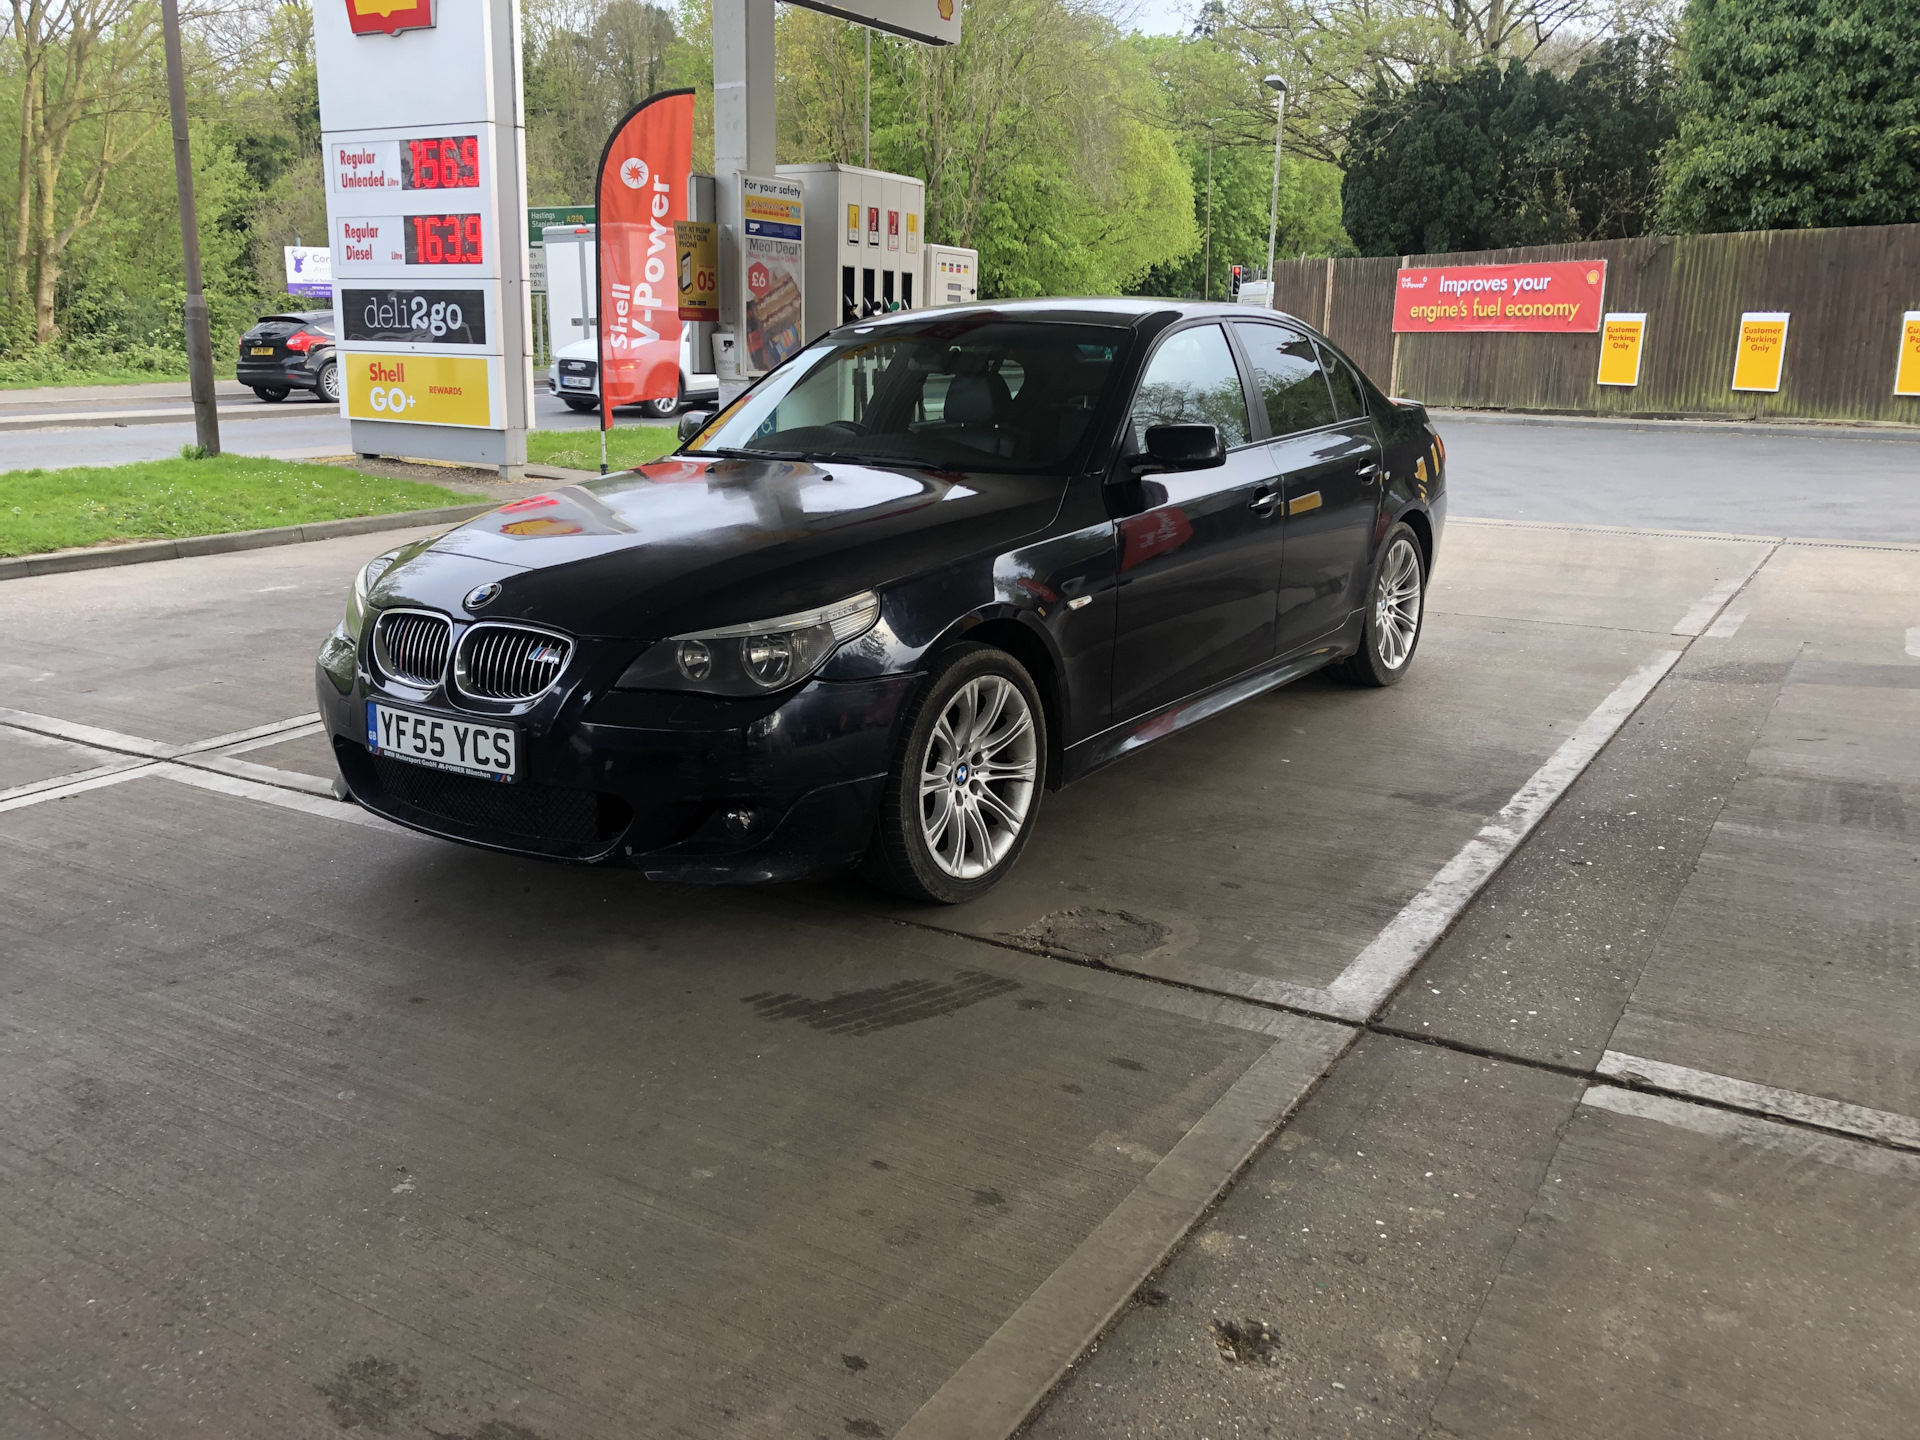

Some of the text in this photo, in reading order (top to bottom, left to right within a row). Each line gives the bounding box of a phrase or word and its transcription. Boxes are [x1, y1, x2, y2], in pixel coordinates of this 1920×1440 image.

[340, 138, 480, 188] Regular 156.9
[341, 170, 399, 188] Unleaded Litre
[744, 179, 801, 198] For your safety
[531, 212, 556, 220] Hastings
[344, 222, 379, 243] Regular
[346, 215, 483, 263] Diesel Litre 163.9
[749, 239, 773, 252] Meal
[312, 254, 331, 263] Cor
[631, 175, 670, 349] V-Power
[697, 270, 716, 292] 05
[752, 272, 766, 287] £6
[1439, 276, 1552, 297] Improves your
[364, 296, 463, 337] deli2go
[610, 283, 631, 349] Shell
[1410, 297, 1580, 323] engine's fuel economy
[1608, 334, 1636, 342] Parking
[1743, 326, 1782, 334] Customer
[1745, 335, 1778, 344] Parking
[1612, 342, 1630, 350] Only
[1750, 344, 1770, 353] Only
[369, 362, 405, 383] Shell
[370, 386, 416, 413] GO+
[429, 386, 462, 396] REWARDS
[368, 711, 511, 769] GB YF55 YCS
[396, 753, 421, 764] Motorsport
[421, 760, 437, 768] GmbH
[438, 763, 465, 774] M-POWER
[465, 769, 491, 779] München
